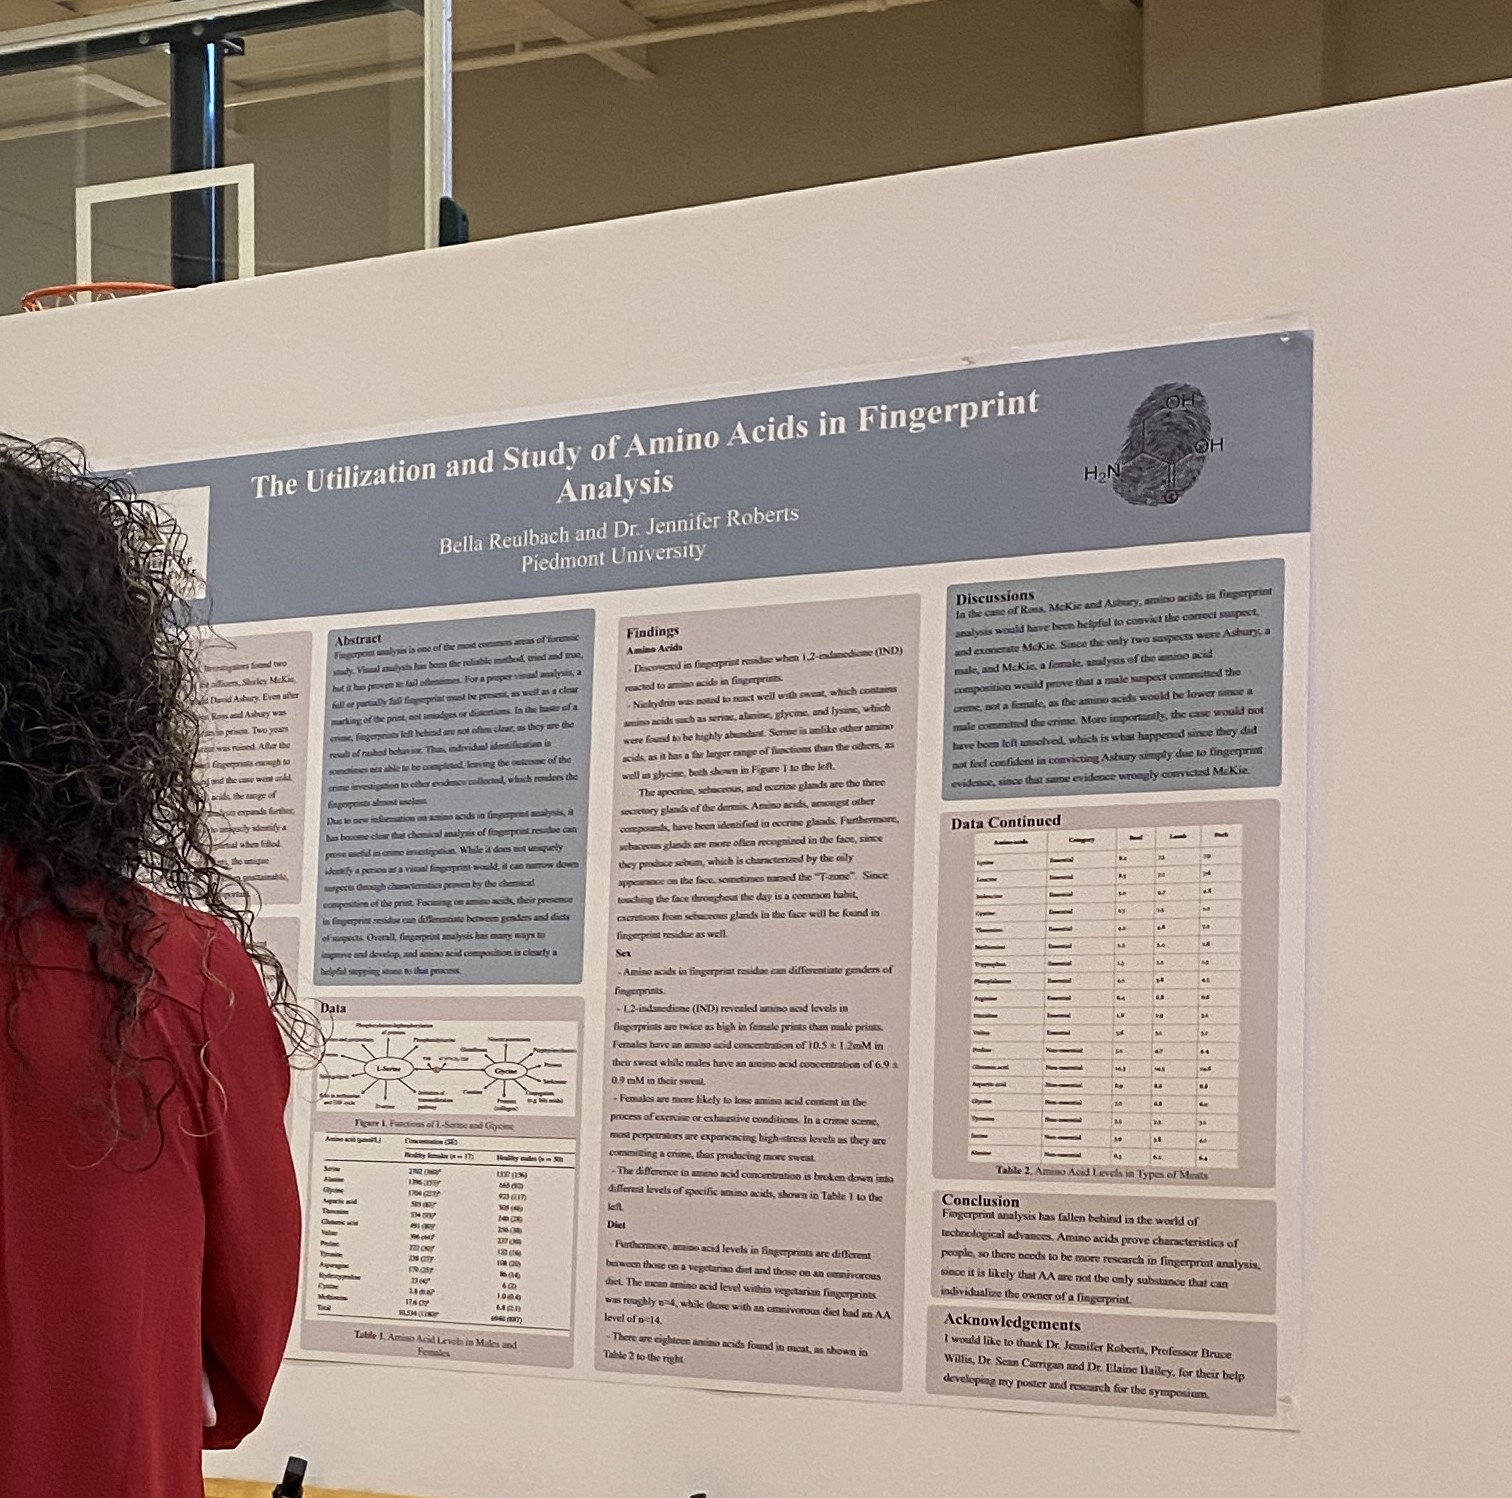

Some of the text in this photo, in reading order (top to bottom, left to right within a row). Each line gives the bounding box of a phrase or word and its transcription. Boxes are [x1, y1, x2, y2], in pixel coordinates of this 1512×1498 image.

[1165, 393, 1195, 410] OH
[250, 389, 1040, 498] The Utilization and Study of Amino Acids in Fingerprint
[1194, 437, 1224, 454] OH
[557, 470, 673, 503] Analysis
[439, 507, 799, 554] Bella Reulbach and Dr. Jennifer Roberts
[521, 541, 706, 572] Piedmont University
[955, 590, 1034, 605] Discussions
[335, 634, 381, 646] Abstract
[626, 625, 679, 639] Findings
[626, 642, 683, 655] Amino Acids
[621, 770, 640, 780] well
[688, 767, 708, 777] both
[709, 766, 739, 776] shown
[750, 764, 780, 775] Figure
[998, 776, 1023, 786] since
[1024, 774, 1043, 785] that
[1045, 775, 1071, 784] same
[1072, 772, 1116, 782] evidence
[1118, 769, 1159, 781] wrongly
[1160, 766, 1210, 778] convicted
[951, 814, 1061, 830] Data Continued
[615, 948, 631, 957] Sex
[320, 1001, 346, 1017] Data
[996, 1164, 1022, 1174] Table
[1034, 1166, 1066, 1176] Amino
[1067, 1167, 1090, 1176] Acid
[1091, 1167, 1123, 1177] Levels
[1124, 1170, 1135, 1178] in
[1137, 1168, 1165, 1180] Types
[1166, 1169, 1177, 1179] of
[1178, 1169, 1208, 1180] Meats
[941, 1193, 1020, 1210] Conclusion
[606, 1219, 626, 1229] Diet
[941, 1208, 1198, 1226] Fingerprint analysis has fallen behind in the world of
[941, 1228, 1005, 1240] technological
[1056, 1232, 1091, 1242] Amino
[1092, 1233, 1119, 1243] acids
[1120, 1236, 1150, 1246] prove
[1151, 1236, 1224, 1247] characteristics
[1226, 1238, 1238, 1248] of
[977, 1250, 989, 1258] so
[990, 1248, 1016, 1259] there
[1017, 1250, 1046, 1260] needs
[1047, 1252, 1058, 1261] to
[1059, 1251, 1072, 1262] be
[1074, 1254, 1100, 1263] more
[1102, 1254, 1144, 1264] research
[1146, 1255, 1157, 1265] in
[1159, 1255, 1214, 1269] fingerprint
[940, 1285, 1002, 1298] individualize
[1003, 1288, 1020, 1299] the
[1021, 1291, 1052, 1300] owner
[1053, 1290, 1066, 1301] of
[1067, 1293, 1074, 1302] a
[944, 1313, 1081, 1331] Acknowledgements
[353, 1330, 378, 1341] Table
[387, 1332, 416, 1344] Amino
[415, 1334, 436, 1345] Acid
[436, 1335, 464, 1347] Levels
[475, 1337, 500, 1349] Males
[501, 1339, 518, 1350] and
[944, 1332, 949, 1343] I
[951, 1334, 981, 1345] would
[982, 1335, 1001, 1346] like
[1003, 1338, 1014, 1347] to
[1015, 1337, 1043, 1348] thank
[1064, 1340, 1103, 1352] Jennifer
[1150, 1345, 1198, 1357] Professor
[1200, 1347, 1232, 1359] Bruce
[417, 1347, 451, 1359] Females
[994, 1355, 1019, 1367] Sean
[1021, 1357, 1064, 1371] Carrigan
[1066, 1360, 1085, 1371] and
[1105, 1362, 1138, 1374] Elaine
[1178, 1366, 1193, 1377] for
[1195, 1367, 1219, 1379] their
[1221, 1369, 1245, 1383] help
[942, 1372, 996, 1387] developing
[997, 1378, 1013, 1389] my
[1015, 1379, 1046, 1389] poster
[1048, 1380, 1067, 1390] and
[1068, 1382, 1111, 1392] research
[1113, 1382, 1127, 1393] for
[1130, 1384, 1146, 1395] the
